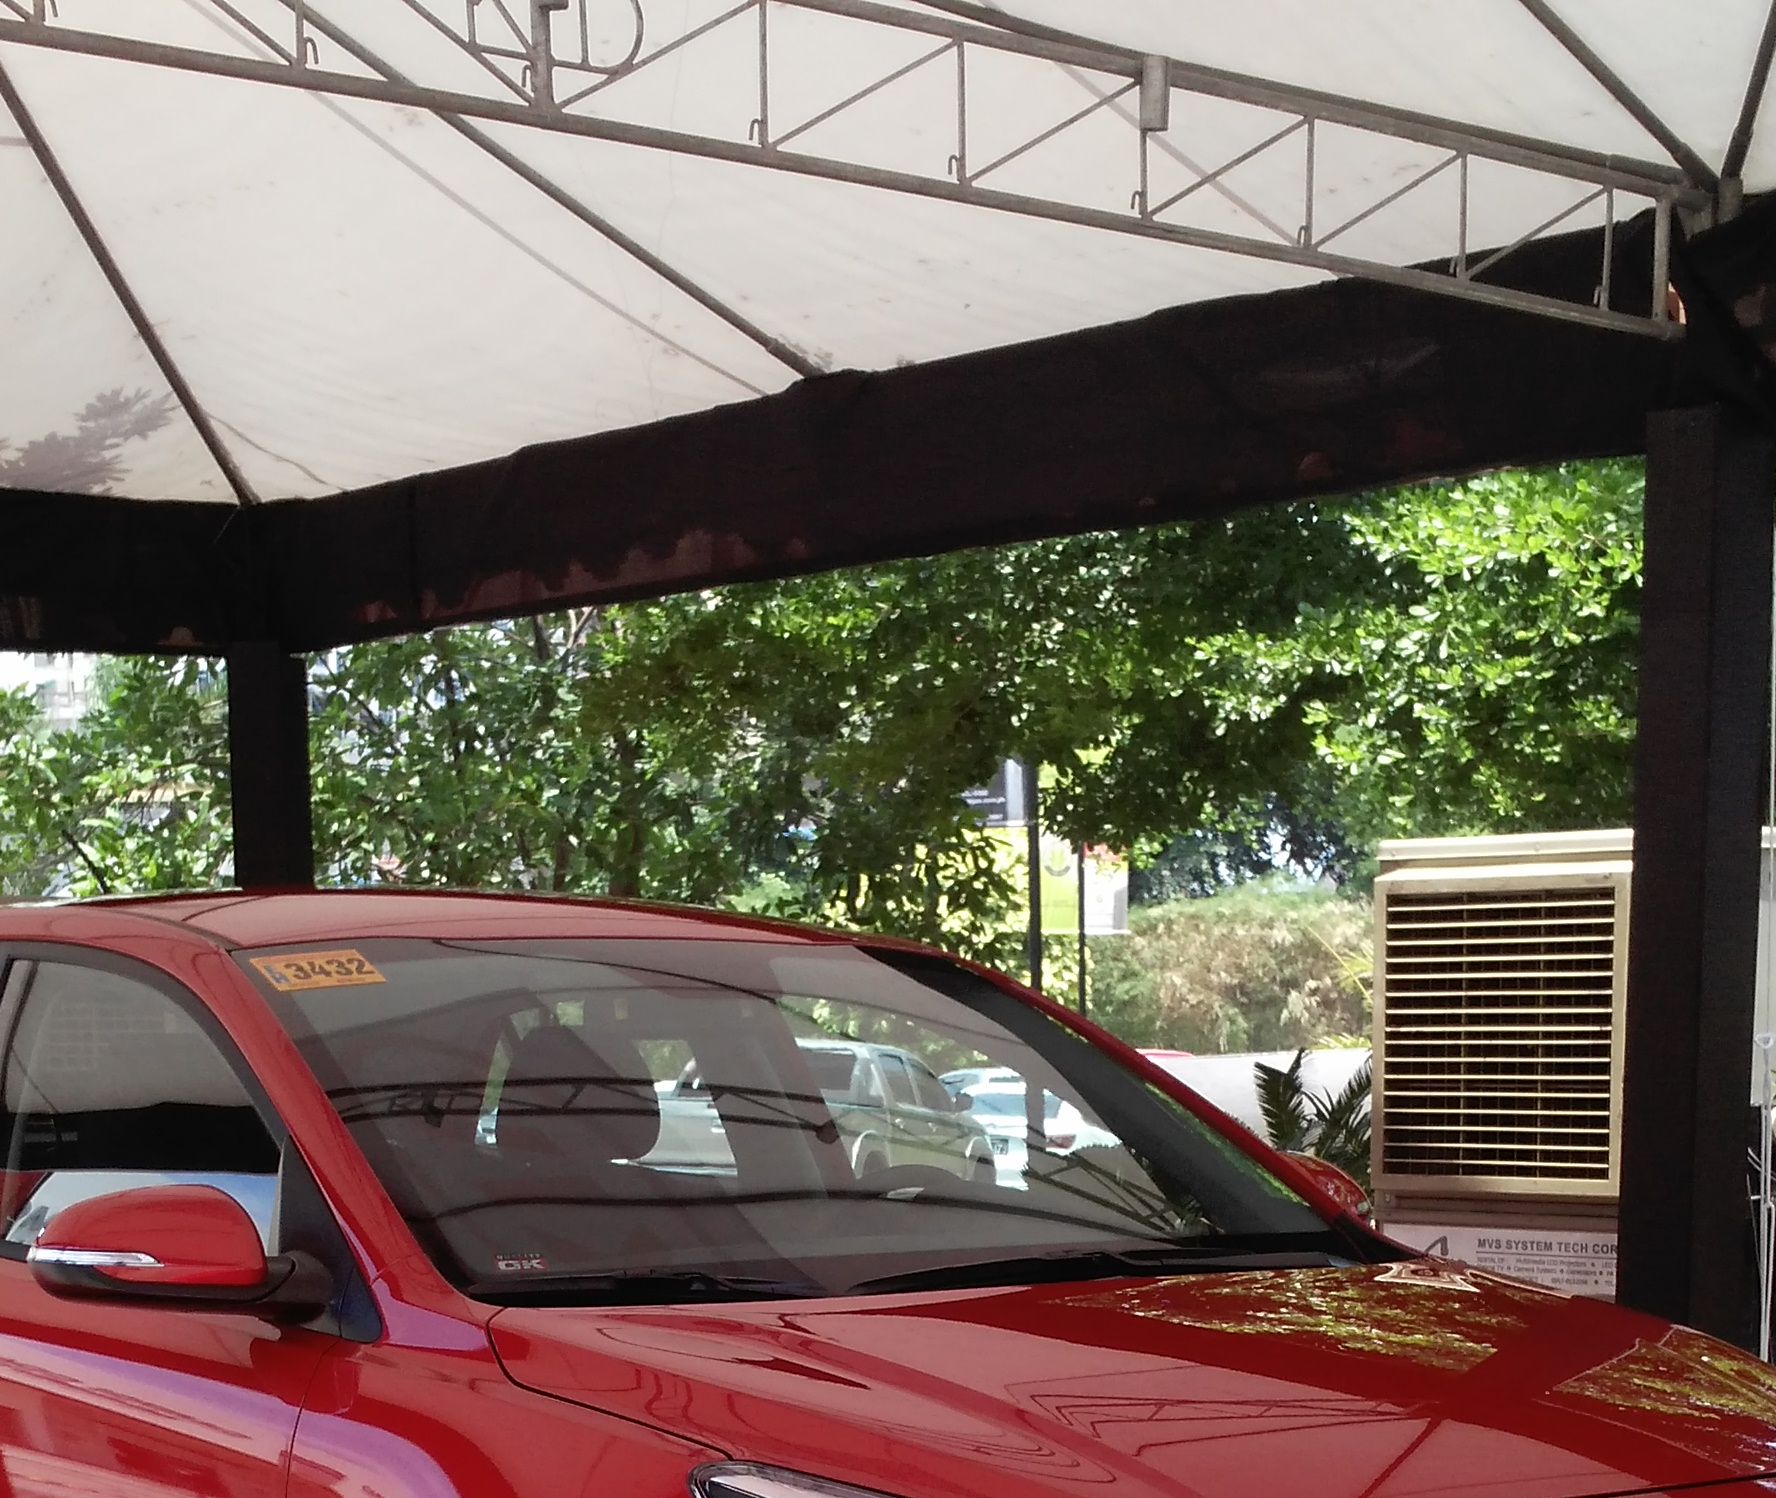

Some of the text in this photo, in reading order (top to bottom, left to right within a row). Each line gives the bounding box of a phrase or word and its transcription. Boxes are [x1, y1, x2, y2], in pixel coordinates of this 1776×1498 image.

[284, 957, 376, 980] 3432
[1477, 1238, 1502, 1250] MVS
[1505, 1240, 1553, 1252] SYSTEM
[1557, 1242, 1588, 1254] TECH
